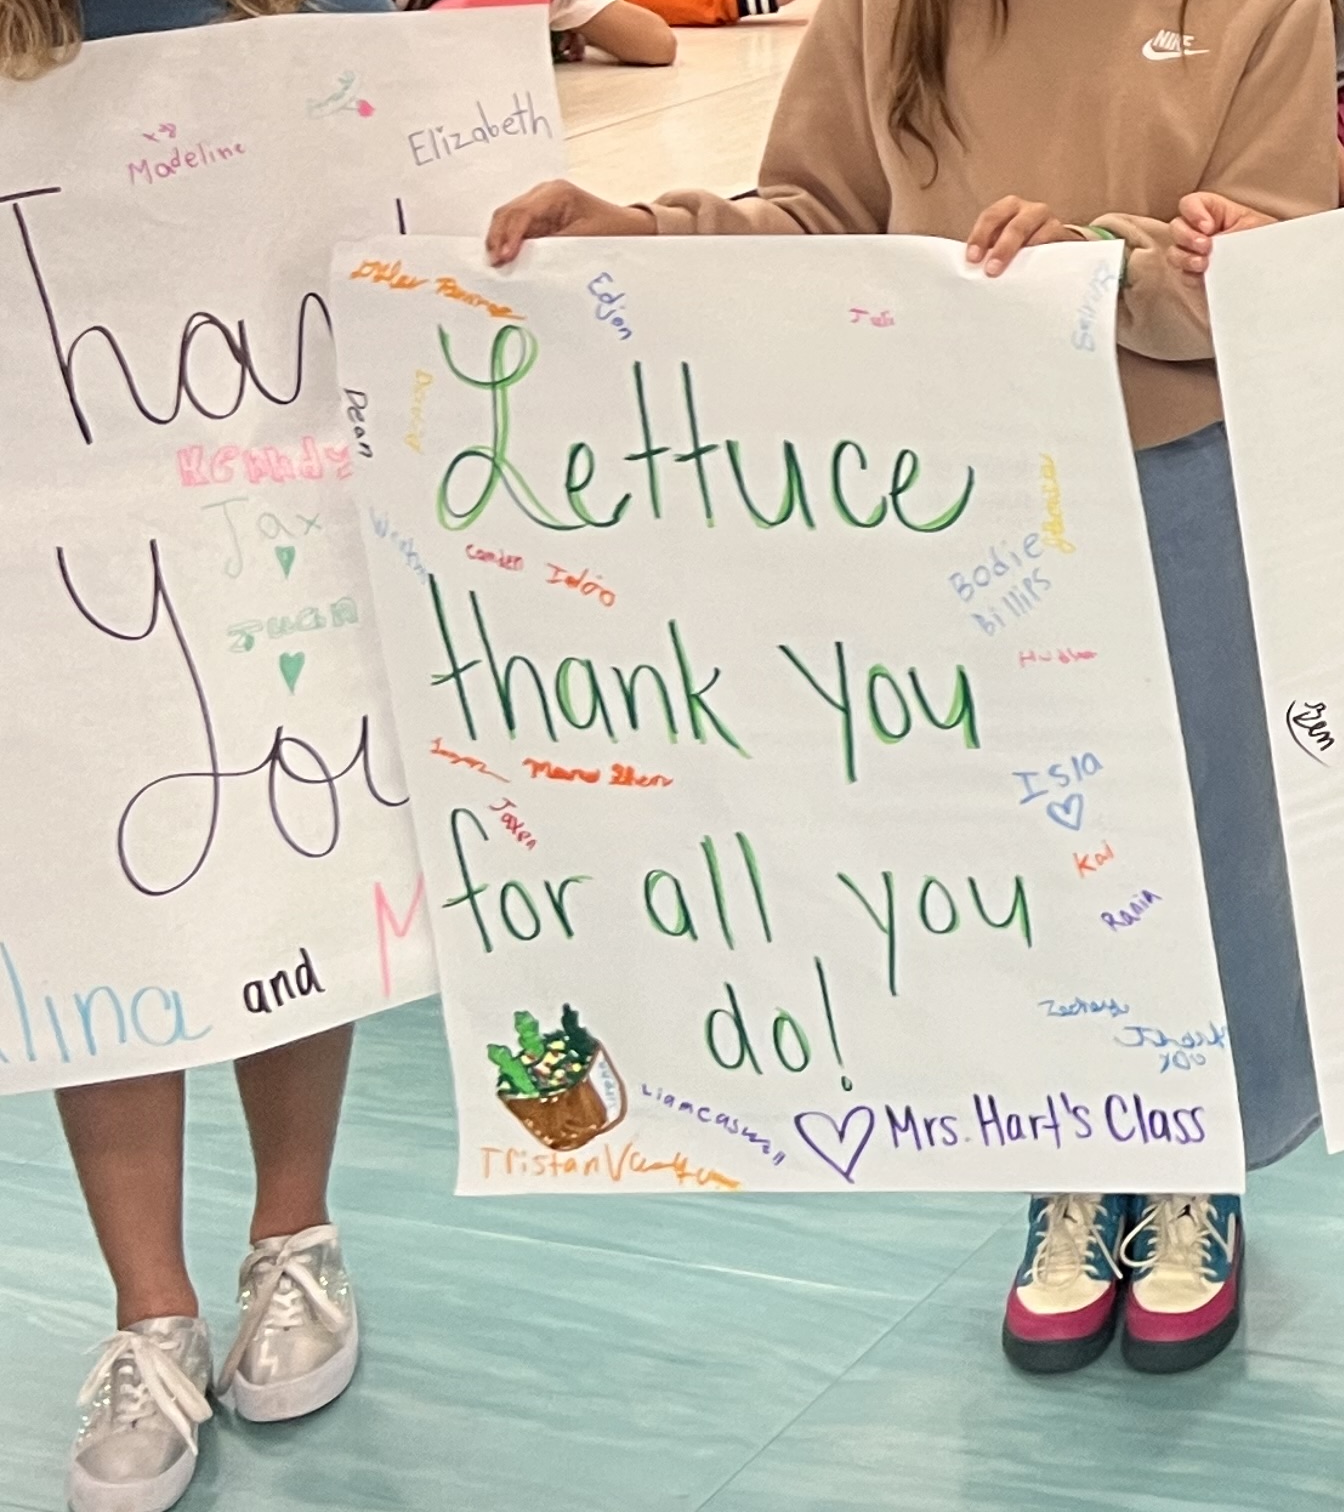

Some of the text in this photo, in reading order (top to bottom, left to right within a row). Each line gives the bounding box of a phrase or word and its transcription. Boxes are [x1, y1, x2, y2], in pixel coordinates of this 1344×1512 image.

[1152, 29, 1195, 51] NIKE
[126, 139, 247, 187] Madeline
[407, 91, 553, 167] Elizabeth
[0, 185, 405, 445] Than
[343, 387, 374, 459] Dean
[436, 324, 975, 534] Lettuce
[200, 494, 323, 580] Jax
[948, 531, 1043, 604] Bodie
[226, 597, 360, 653] Juan
[429, 573, 753, 759] thank
[1012, 752, 1104, 805] Isla
[441, 807, 1033, 997] for all you
[0, 942, 326, 1064] lina and
[704, 956, 854, 1092] do!
[884, 1091, 1207, 1152] Mrs. Hart's Class
